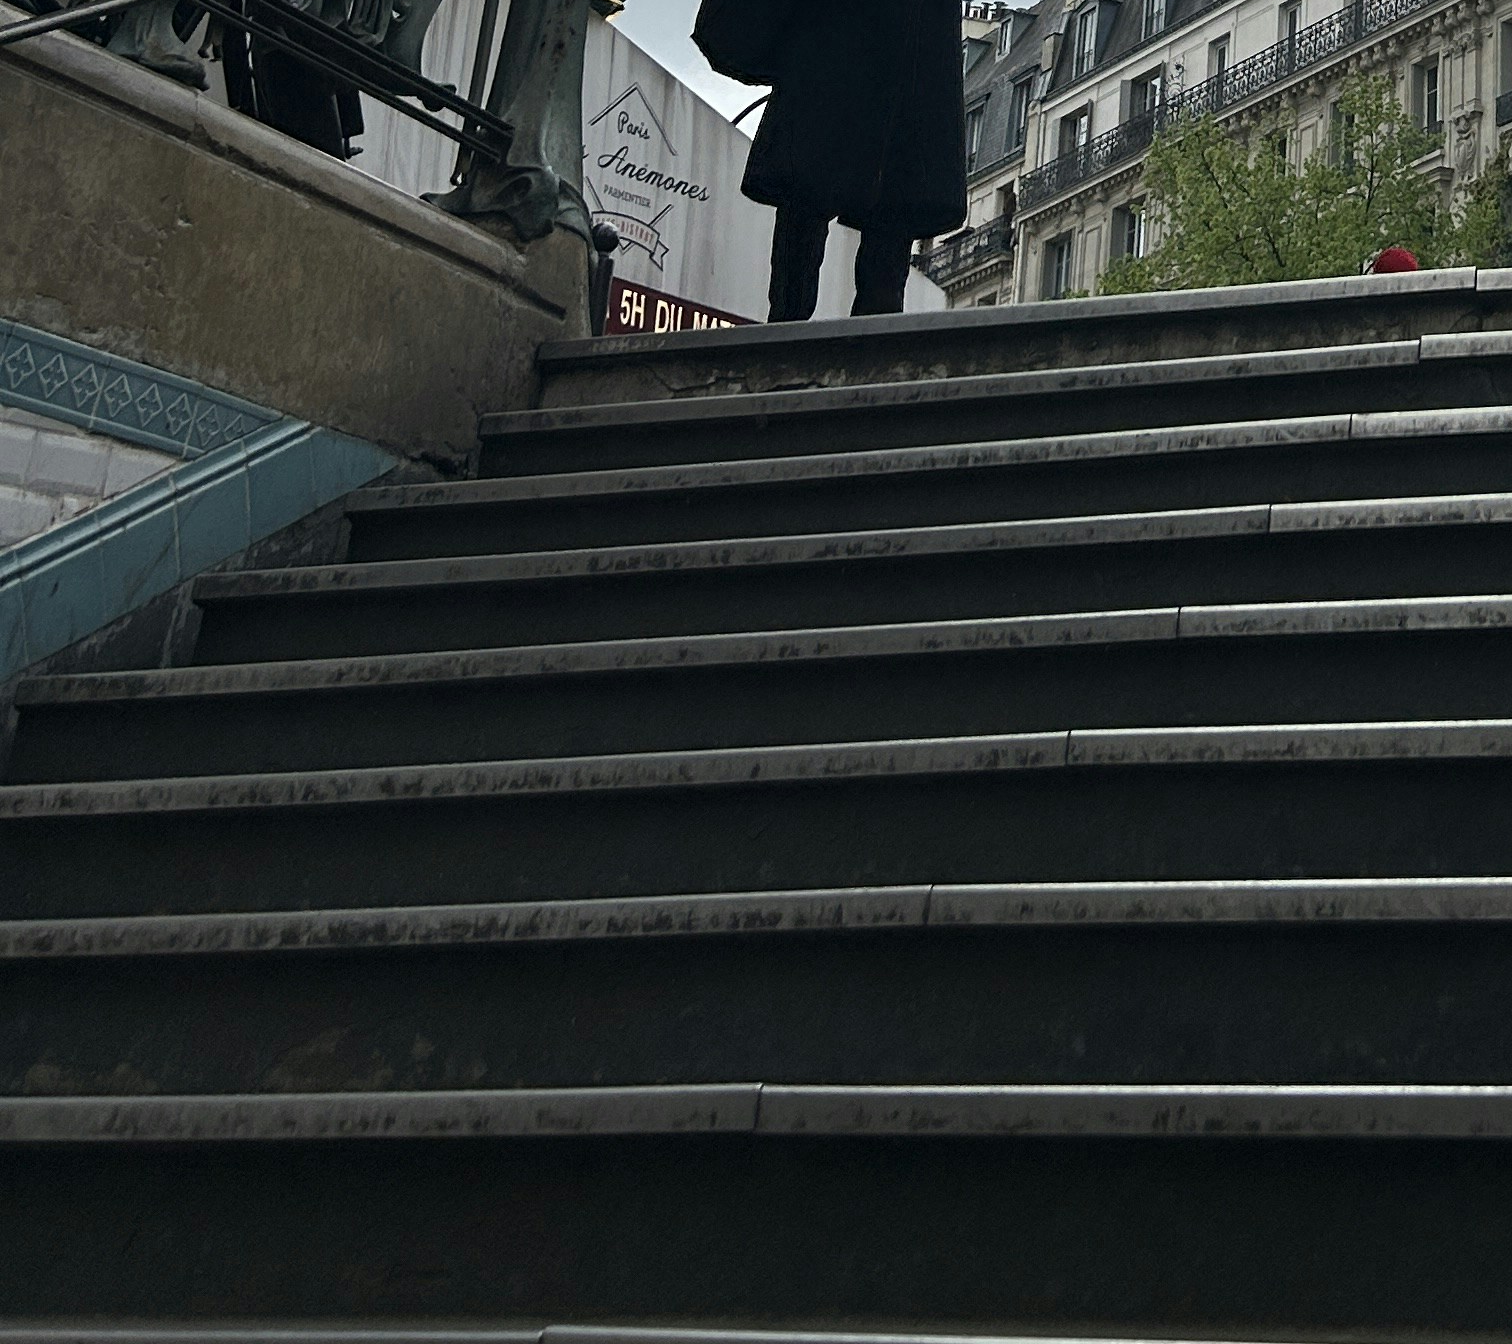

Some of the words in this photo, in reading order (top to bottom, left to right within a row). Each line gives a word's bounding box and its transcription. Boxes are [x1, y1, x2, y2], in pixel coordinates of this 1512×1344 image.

[617, 110, 651, 140] Paris
[597, 145, 710, 202] Anémones
[620, 289, 646, 329] 5H
